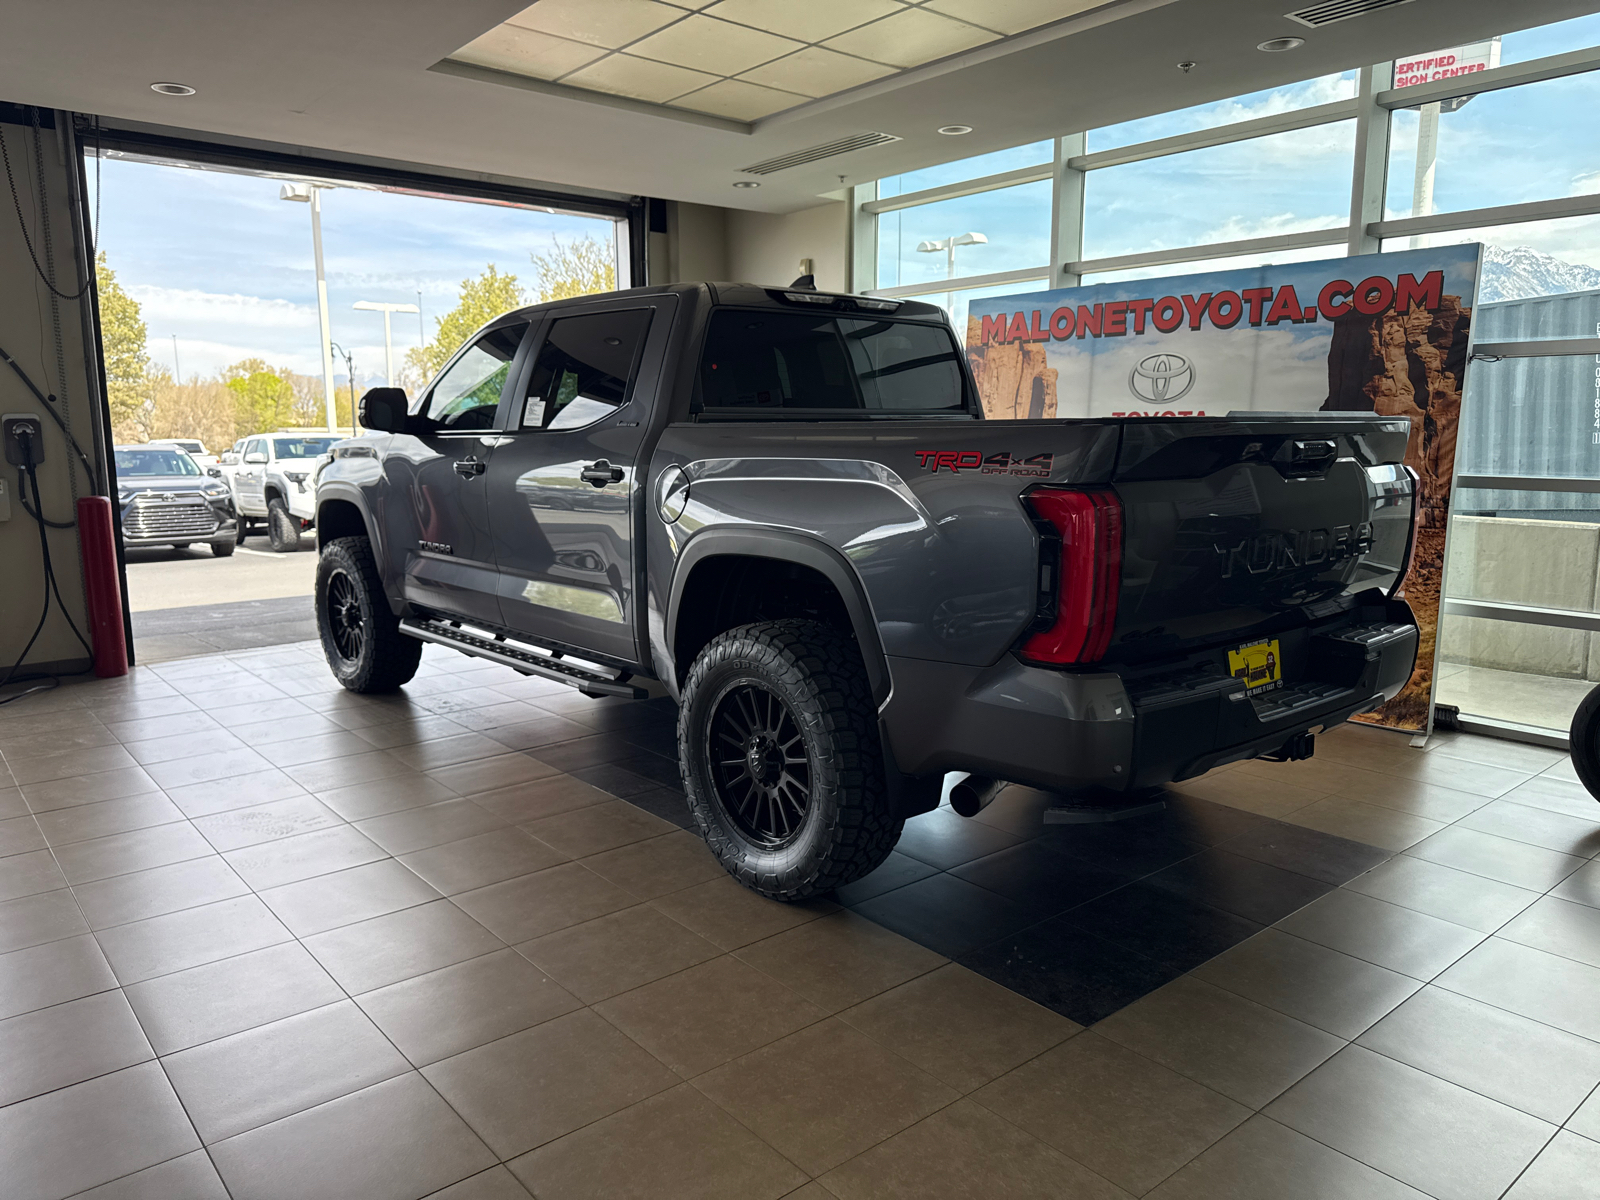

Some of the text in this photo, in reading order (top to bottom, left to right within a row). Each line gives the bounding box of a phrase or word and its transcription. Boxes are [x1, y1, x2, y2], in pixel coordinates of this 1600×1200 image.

[980, 270, 1444, 346] MALONETOYOTA.COM
[915, 450, 984, 475] TRD
[981, 467, 1052, 478] OFF ROAD
[1214, 521, 1374, 578] TUNDRA
[732, 659, 769, 677] OPEN
